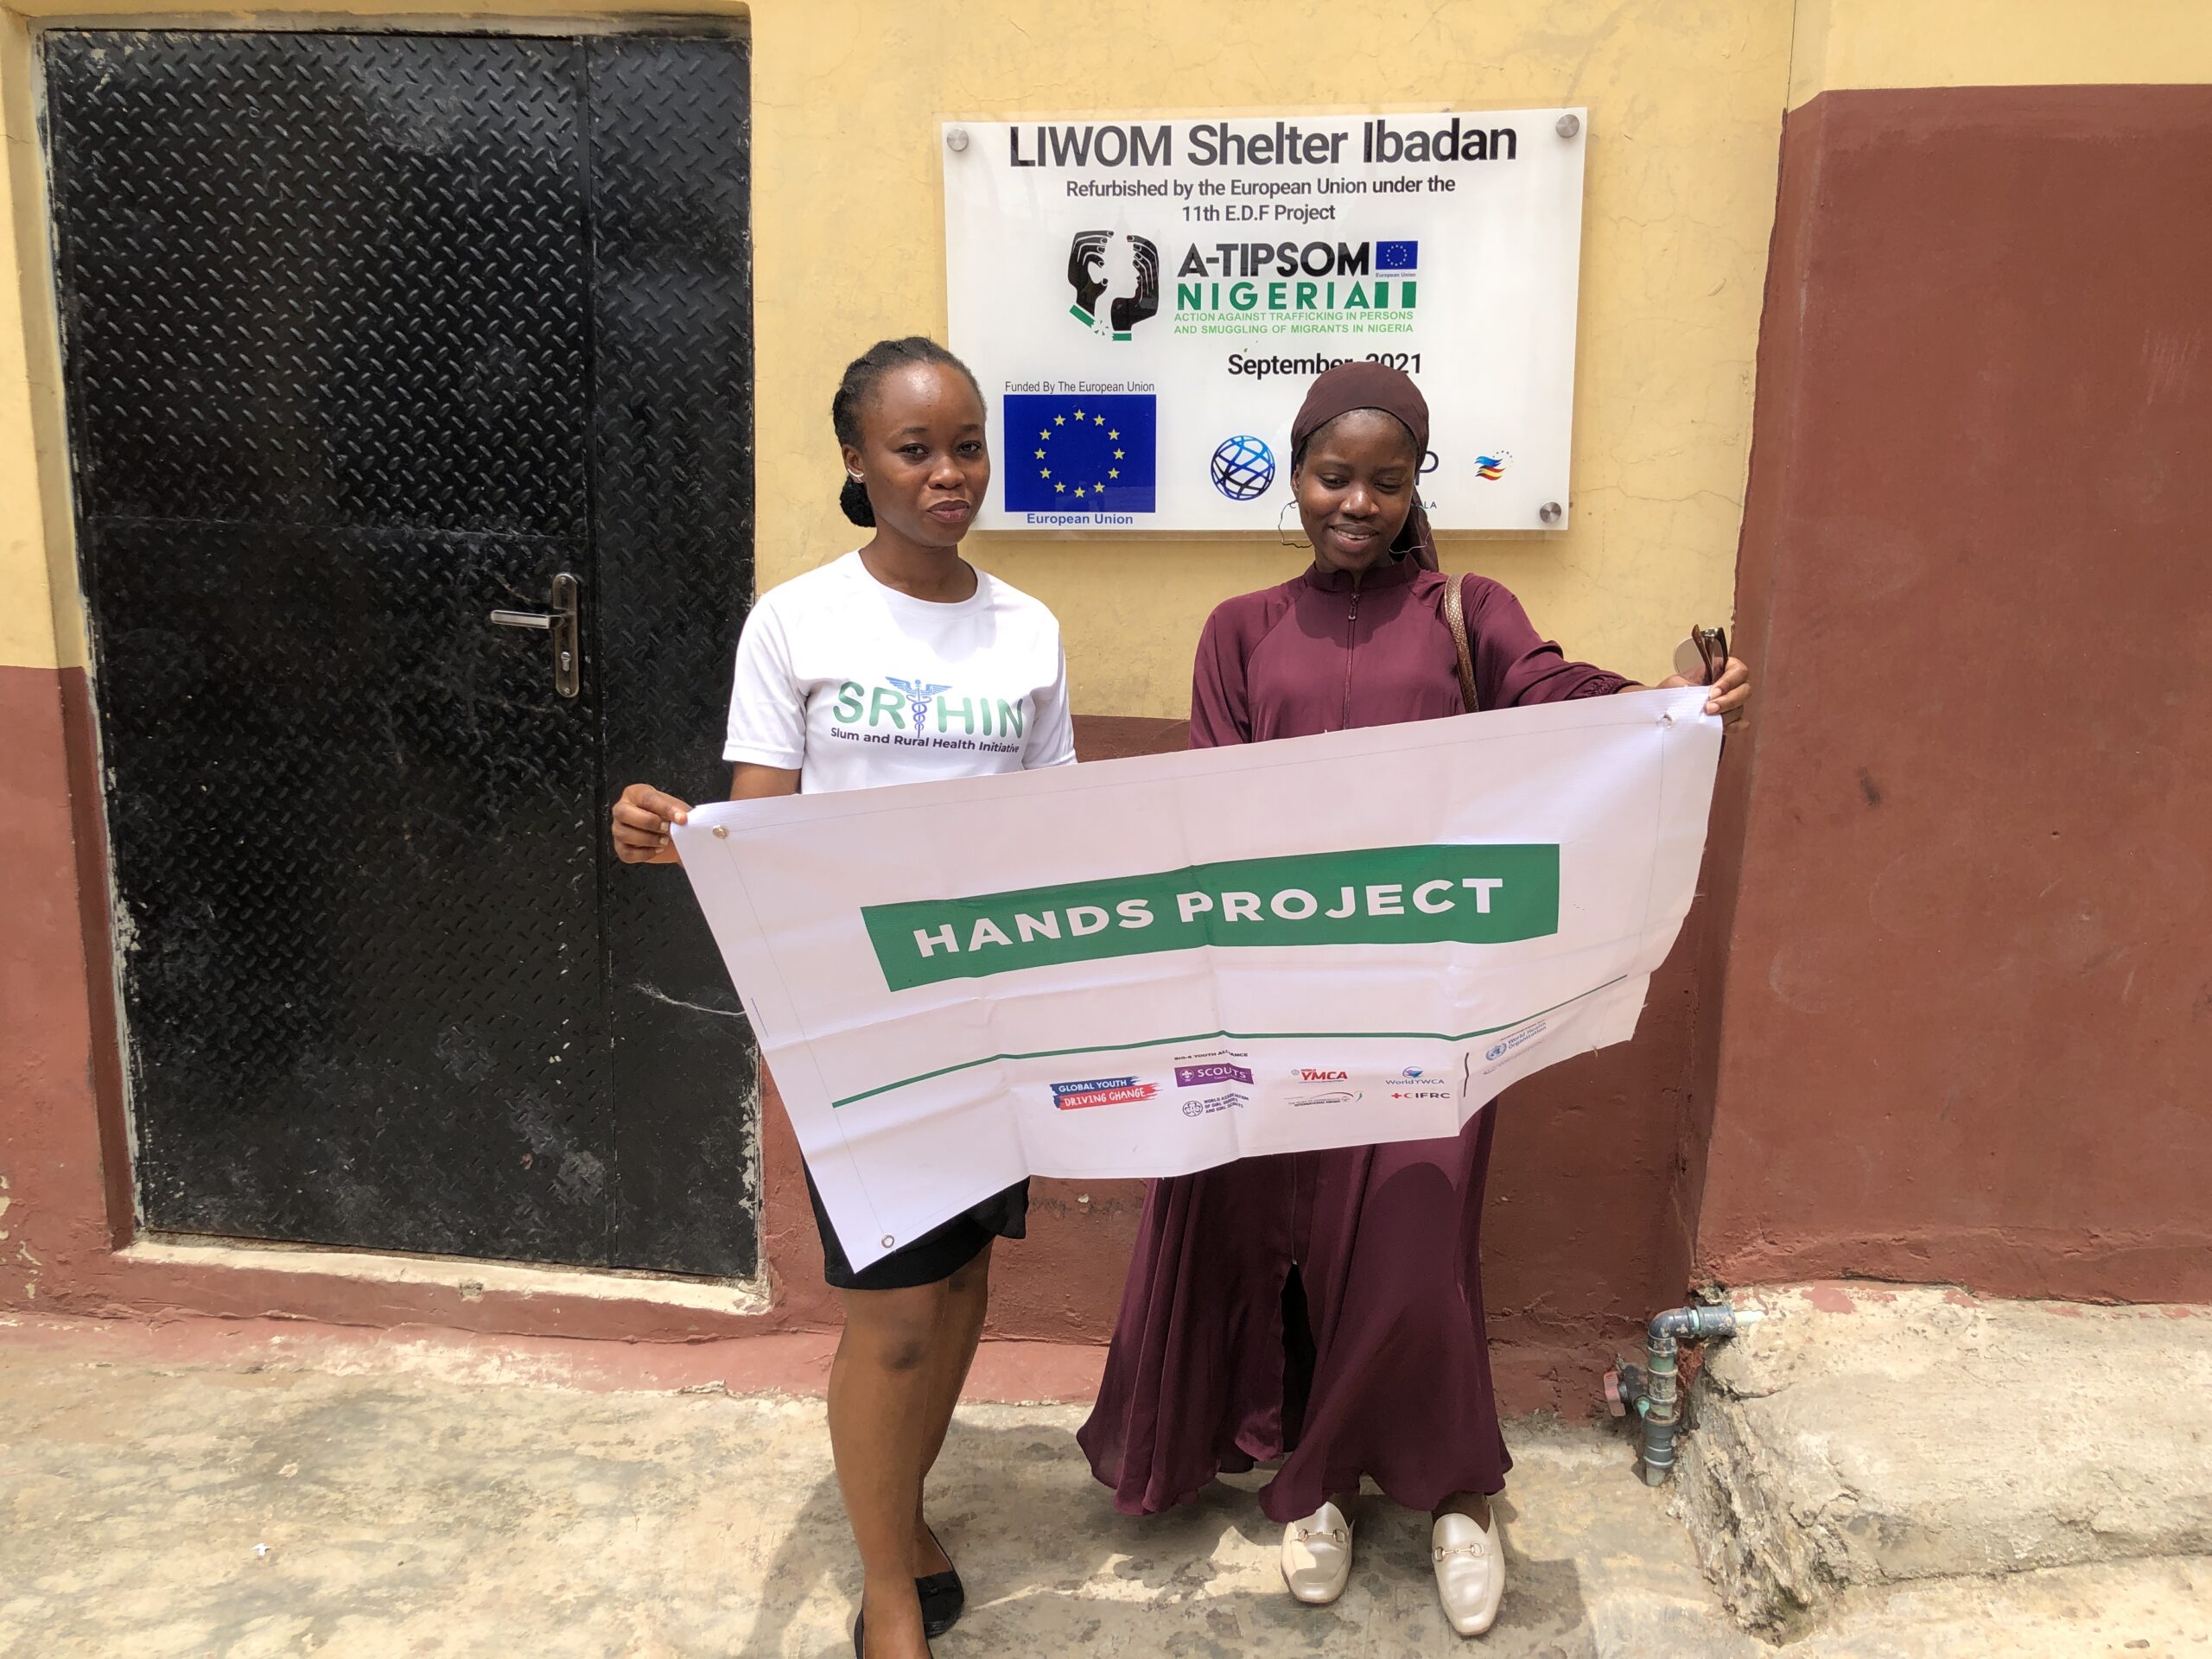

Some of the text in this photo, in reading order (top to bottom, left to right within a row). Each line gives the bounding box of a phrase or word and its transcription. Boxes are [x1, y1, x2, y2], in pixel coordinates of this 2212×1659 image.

[1010, 118, 1517, 167] LIWOM Shelter Ibadan
[1066, 175, 1456, 200] Refurbished by the European Union under the
[1182, 204, 1336, 225] 11th E.D.F Project
[1177, 241, 1370, 277] A-TIPSOM
[1177, 281, 1370, 311] NIGERIA
[1174, 311, 1414, 321] ACTION AGAINST TRAFFICKING IN PERSONS
[1174, 323, 1414, 334] AND SMUGGLING OF MIGRANTS IN NIGERIA
[1005, 381, 1155, 394] Funded By The European Union
[1027, 513, 1133, 526] European Union
[830, 727, 1020, 753] Slum and Rural Health Initiative
[912, 878, 1503, 958] HANDS PROJECT
[1197, 1067, 1247, 1079] SCOUTS
[1301, 1071, 1348, 1080] YMCA
[1058, 1079, 1127, 1093] GLOBAL YOUTH
[1064, 1087, 1146, 1107] DRIVING CHANGE
